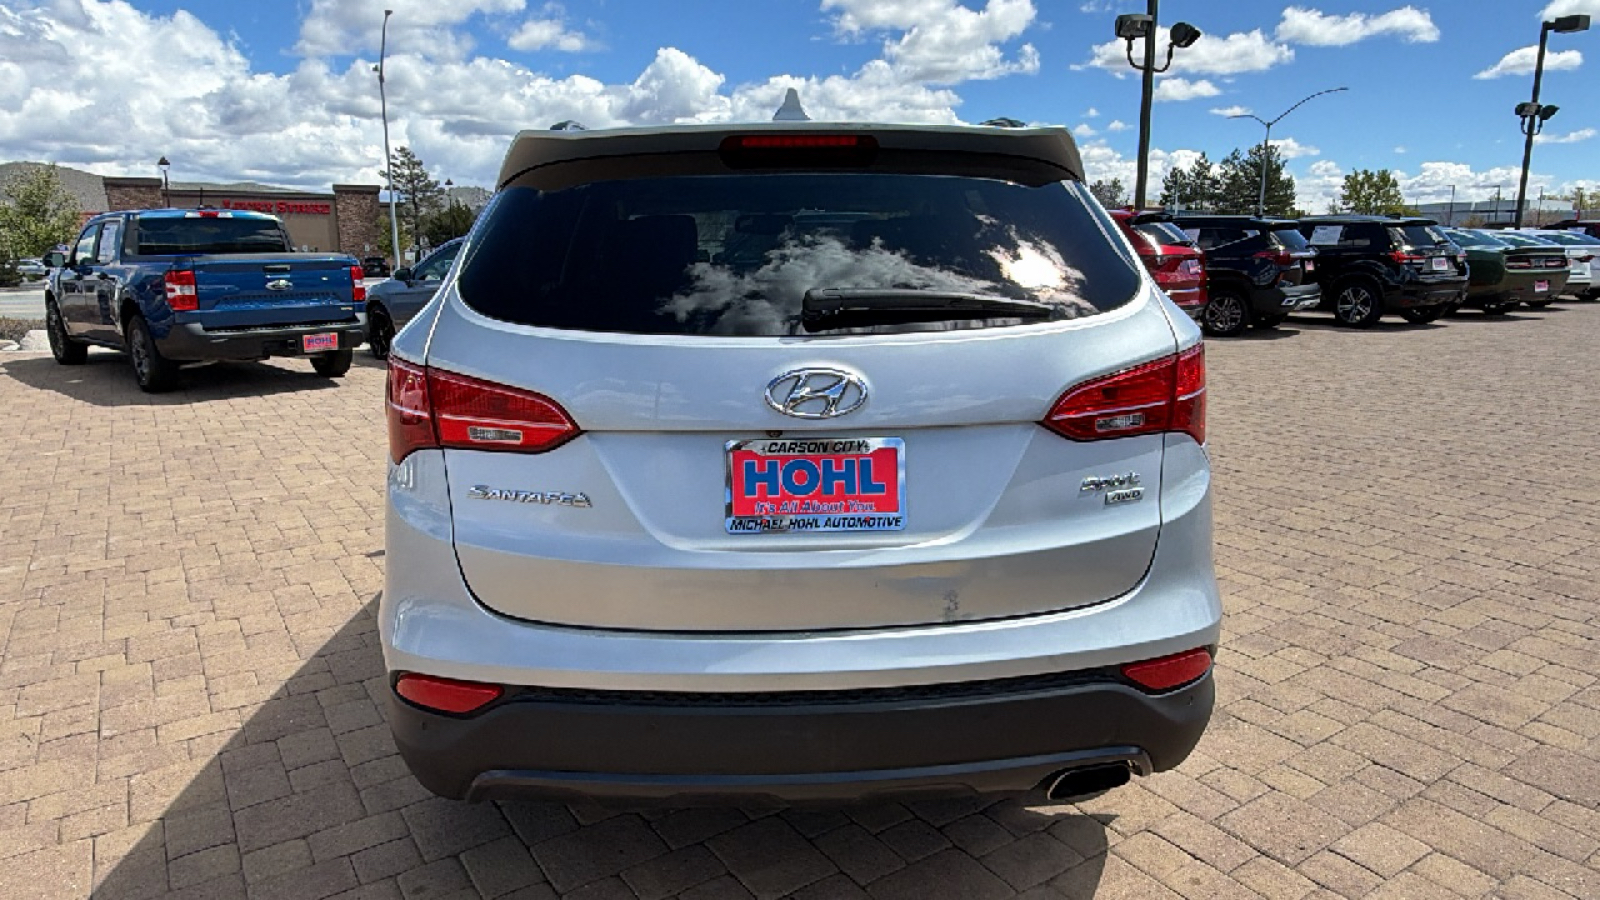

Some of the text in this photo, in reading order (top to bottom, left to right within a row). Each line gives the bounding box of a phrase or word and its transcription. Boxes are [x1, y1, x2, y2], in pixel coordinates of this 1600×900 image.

[767, 440, 866, 454] CARSON CITY
[743, 458, 887, 497] HOHL
[1111, 489, 1142, 501] AWD
[754, 500, 776, 514] It's
[779, 500, 799, 514] All
[801, 499, 845, 513] About
[729, 516, 904, 532] MICHAEL HOHL AUTOMOTIVE
